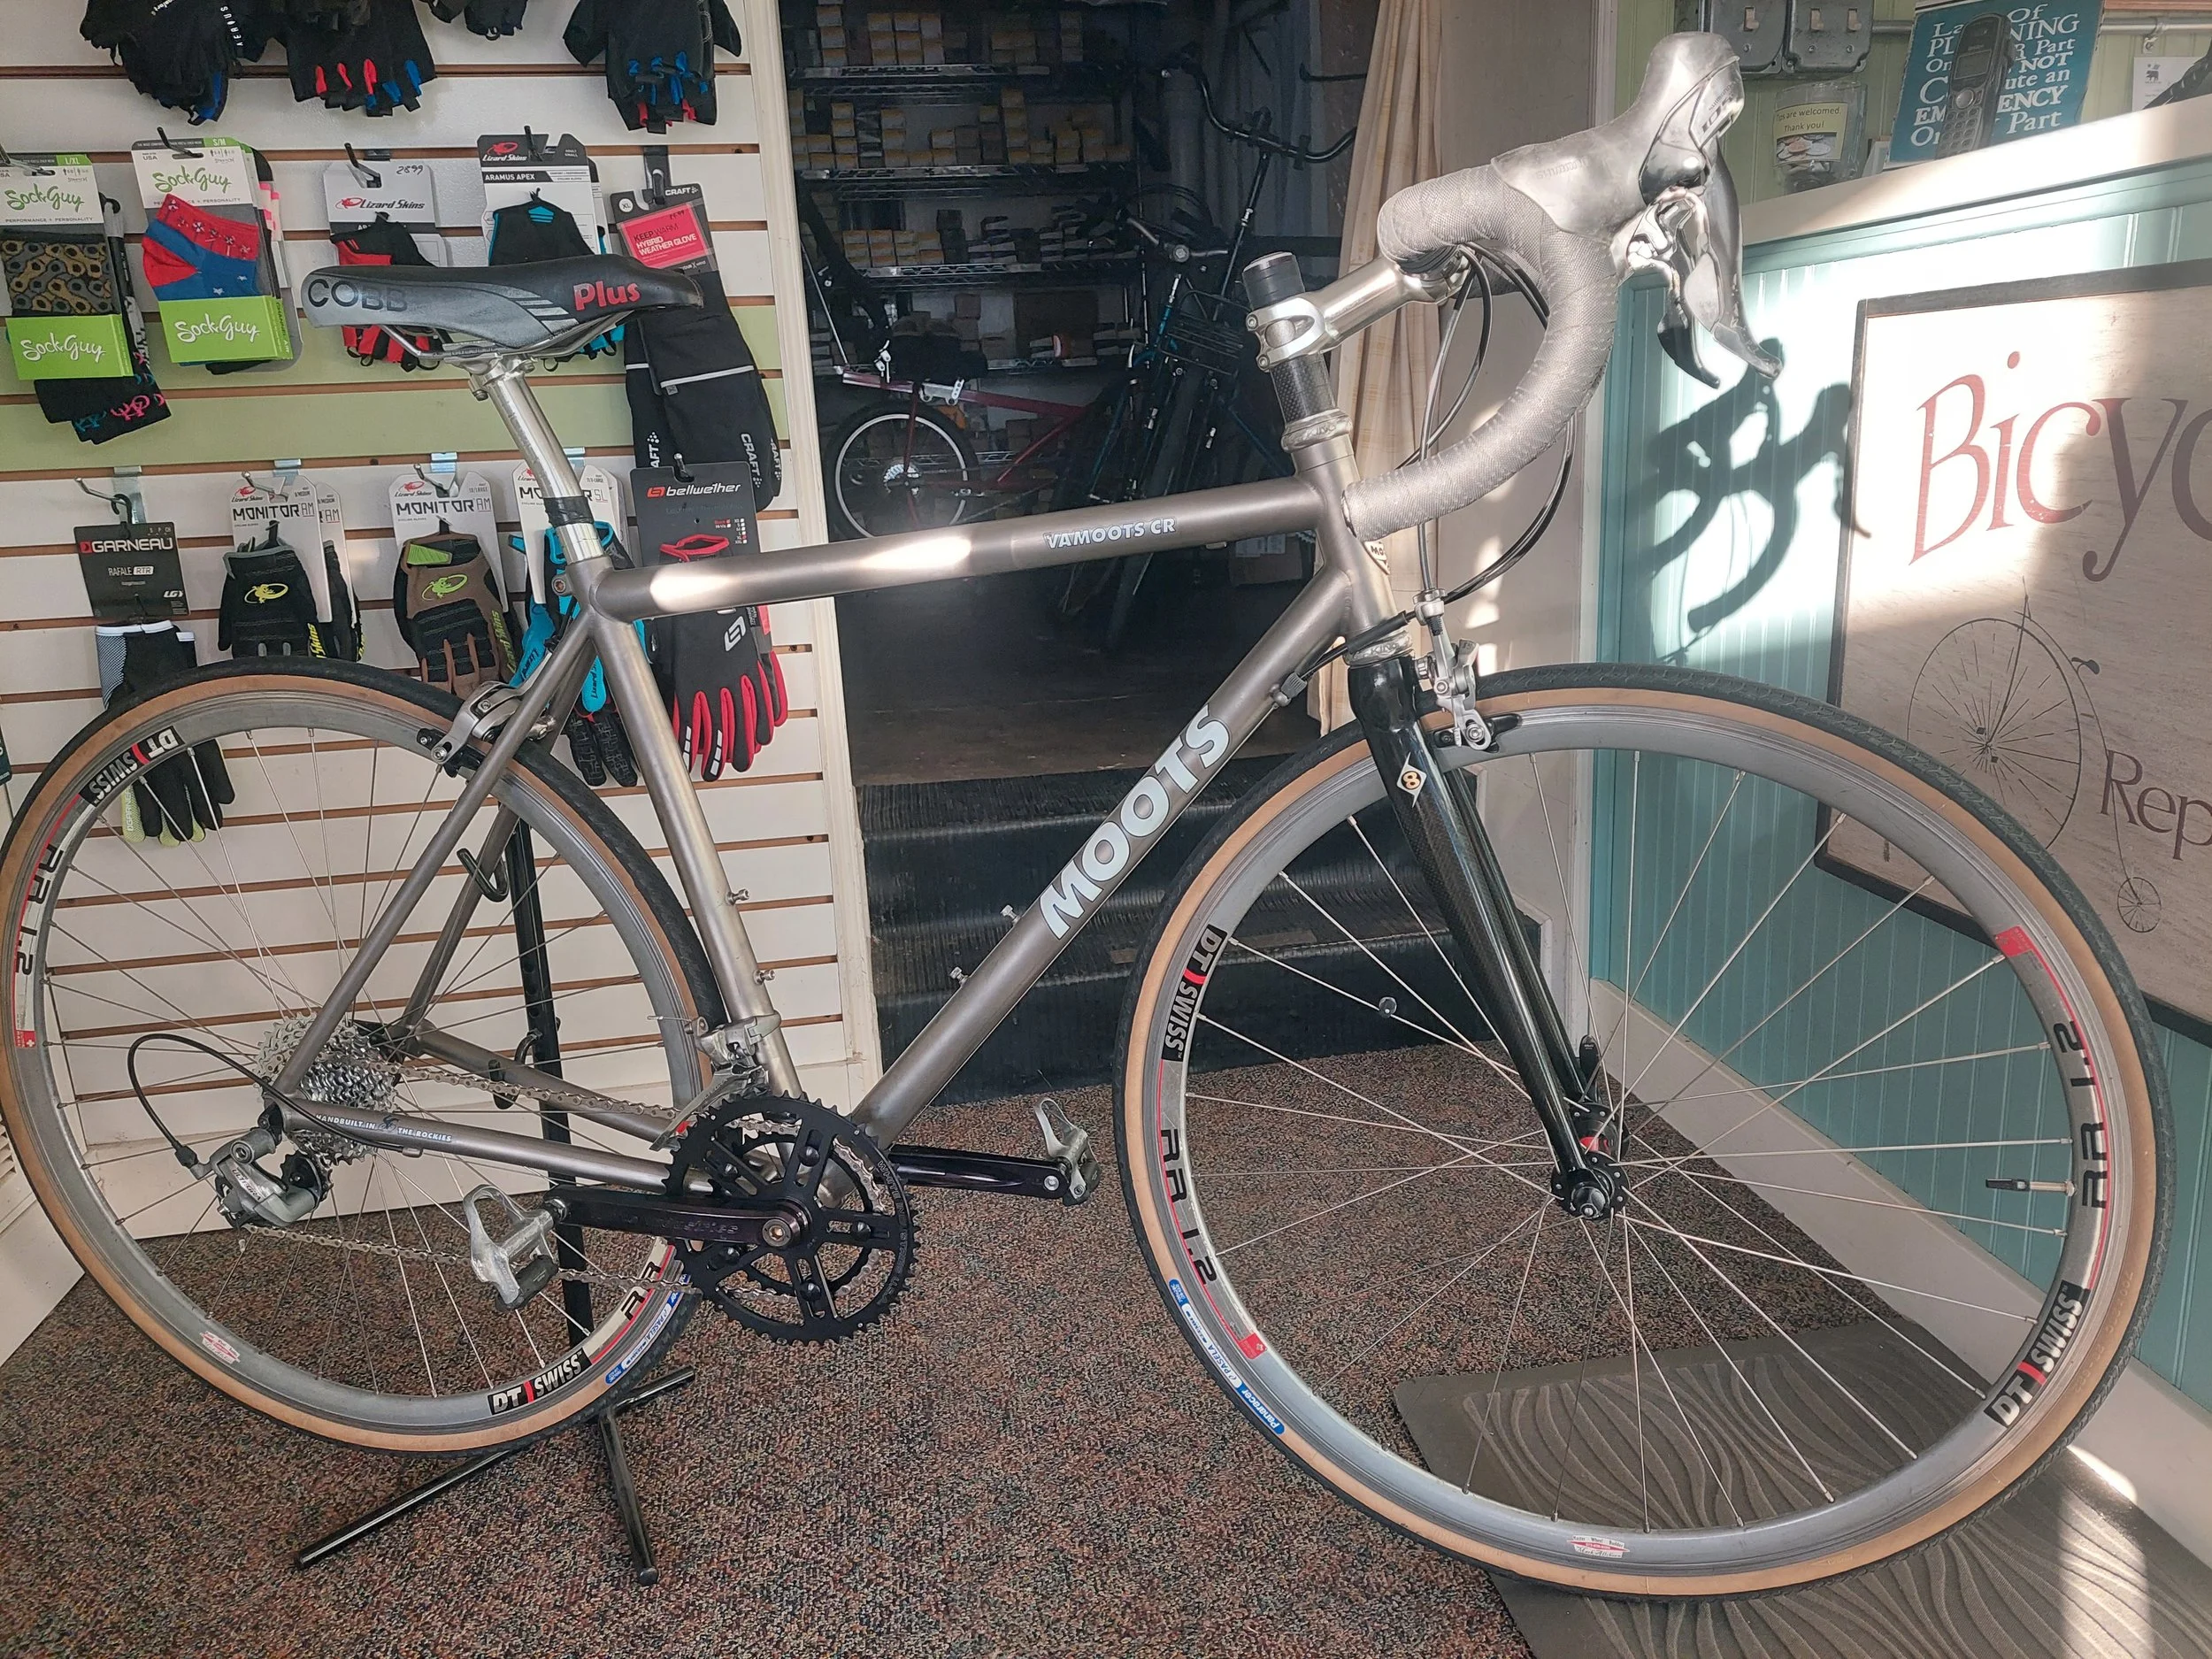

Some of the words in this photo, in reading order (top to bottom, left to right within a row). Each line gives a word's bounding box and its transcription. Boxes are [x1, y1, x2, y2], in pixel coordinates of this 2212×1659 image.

[2007, 4, 2048, 23] Of
[2035, 38, 2076, 57] Part
[2019, 51, 2073, 73] NOT
[2046, 69, 2070, 83] an
[2006, 111, 2062, 134] Part
[65, 157, 81, 165] L/XL
[664, 187, 691, 196] CRAFT
[359, 199, 395, 209] Lizard
[395, 199, 426, 210] Skins
[633, 231, 654, 242] KEEP
[636, 235, 664, 250] HYBRID
[638, 240, 674, 256] WEATHER
[673, 233, 697, 245] GLOVE
[308, 279, 408, 312] COBB
[573, 280, 641, 311] Plus
[649, 444, 660, 468] AFT
[741, 433, 761, 477] CRAFT
[666, 483, 741, 497] bellwether
[233, 504, 300, 521] MONITOR
[396, 500, 474, 515] MONITOR
[91, 537, 173, 553] GARNEAU
[1044, 522, 1146, 549] VAMOOTS
[1150, 518, 1176, 534] CR
[108, 567, 133, 576] RAFALE
[146, 727, 180, 758] DT
[89, 751, 138, 801] SWISS
[1040, 703, 1230, 940] MOOTS
[1193, 928, 1223, 972] DT
[1164, 981, 1198, 1051] SWISS
[316, 1114, 363, 1128] HANDBUILT
[398, 1127, 413, 1136] THE
[416, 1130, 452, 1143] ROCKIES
[232, 1169, 261, 1201] ULTEGRA
[1207, 1343, 1232, 1377] PASELA
[1992, 1375, 2033, 1426] DT
[2031, 1292, 2083, 1372] SWISS
[493, 1386, 524, 1414] DT
[534, 1355, 582, 1398] SWISS
[1240, 1388, 1280, 1429] Panaracer
